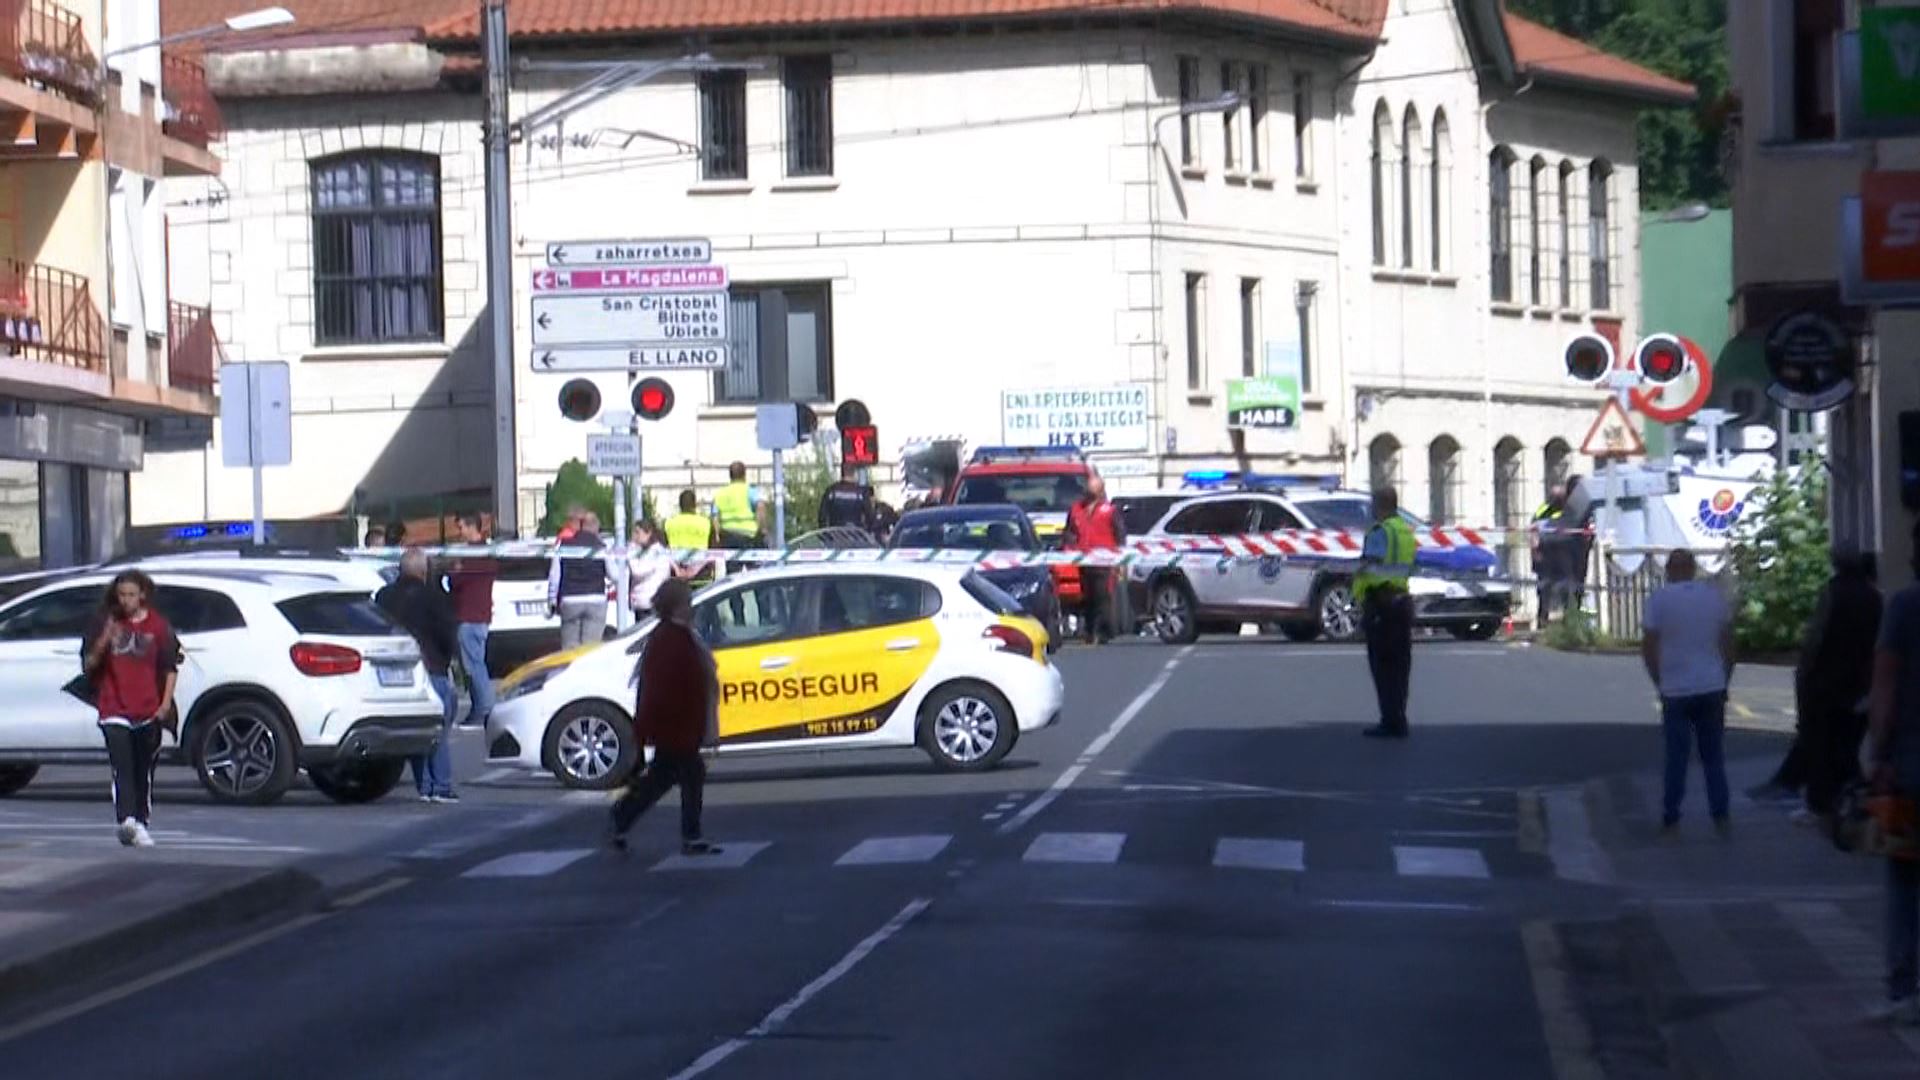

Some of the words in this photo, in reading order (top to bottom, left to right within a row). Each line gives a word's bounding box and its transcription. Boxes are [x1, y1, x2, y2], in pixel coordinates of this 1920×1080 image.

[596, 246, 703, 261] zaharretxea
[602, 273, 621, 286] La
[627, 270, 719, 286] Magdalena
[602, 297, 633, 311] San
[640, 295, 717, 310] Cristobal
[629, 351, 650, 366] EL
[656, 350, 718, 365] LLANO
[1239, 408, 1287, 424] HABE
[1048, 430, 1105, 447] HABE
[722, 672, 879, 705] PROSEGUR
